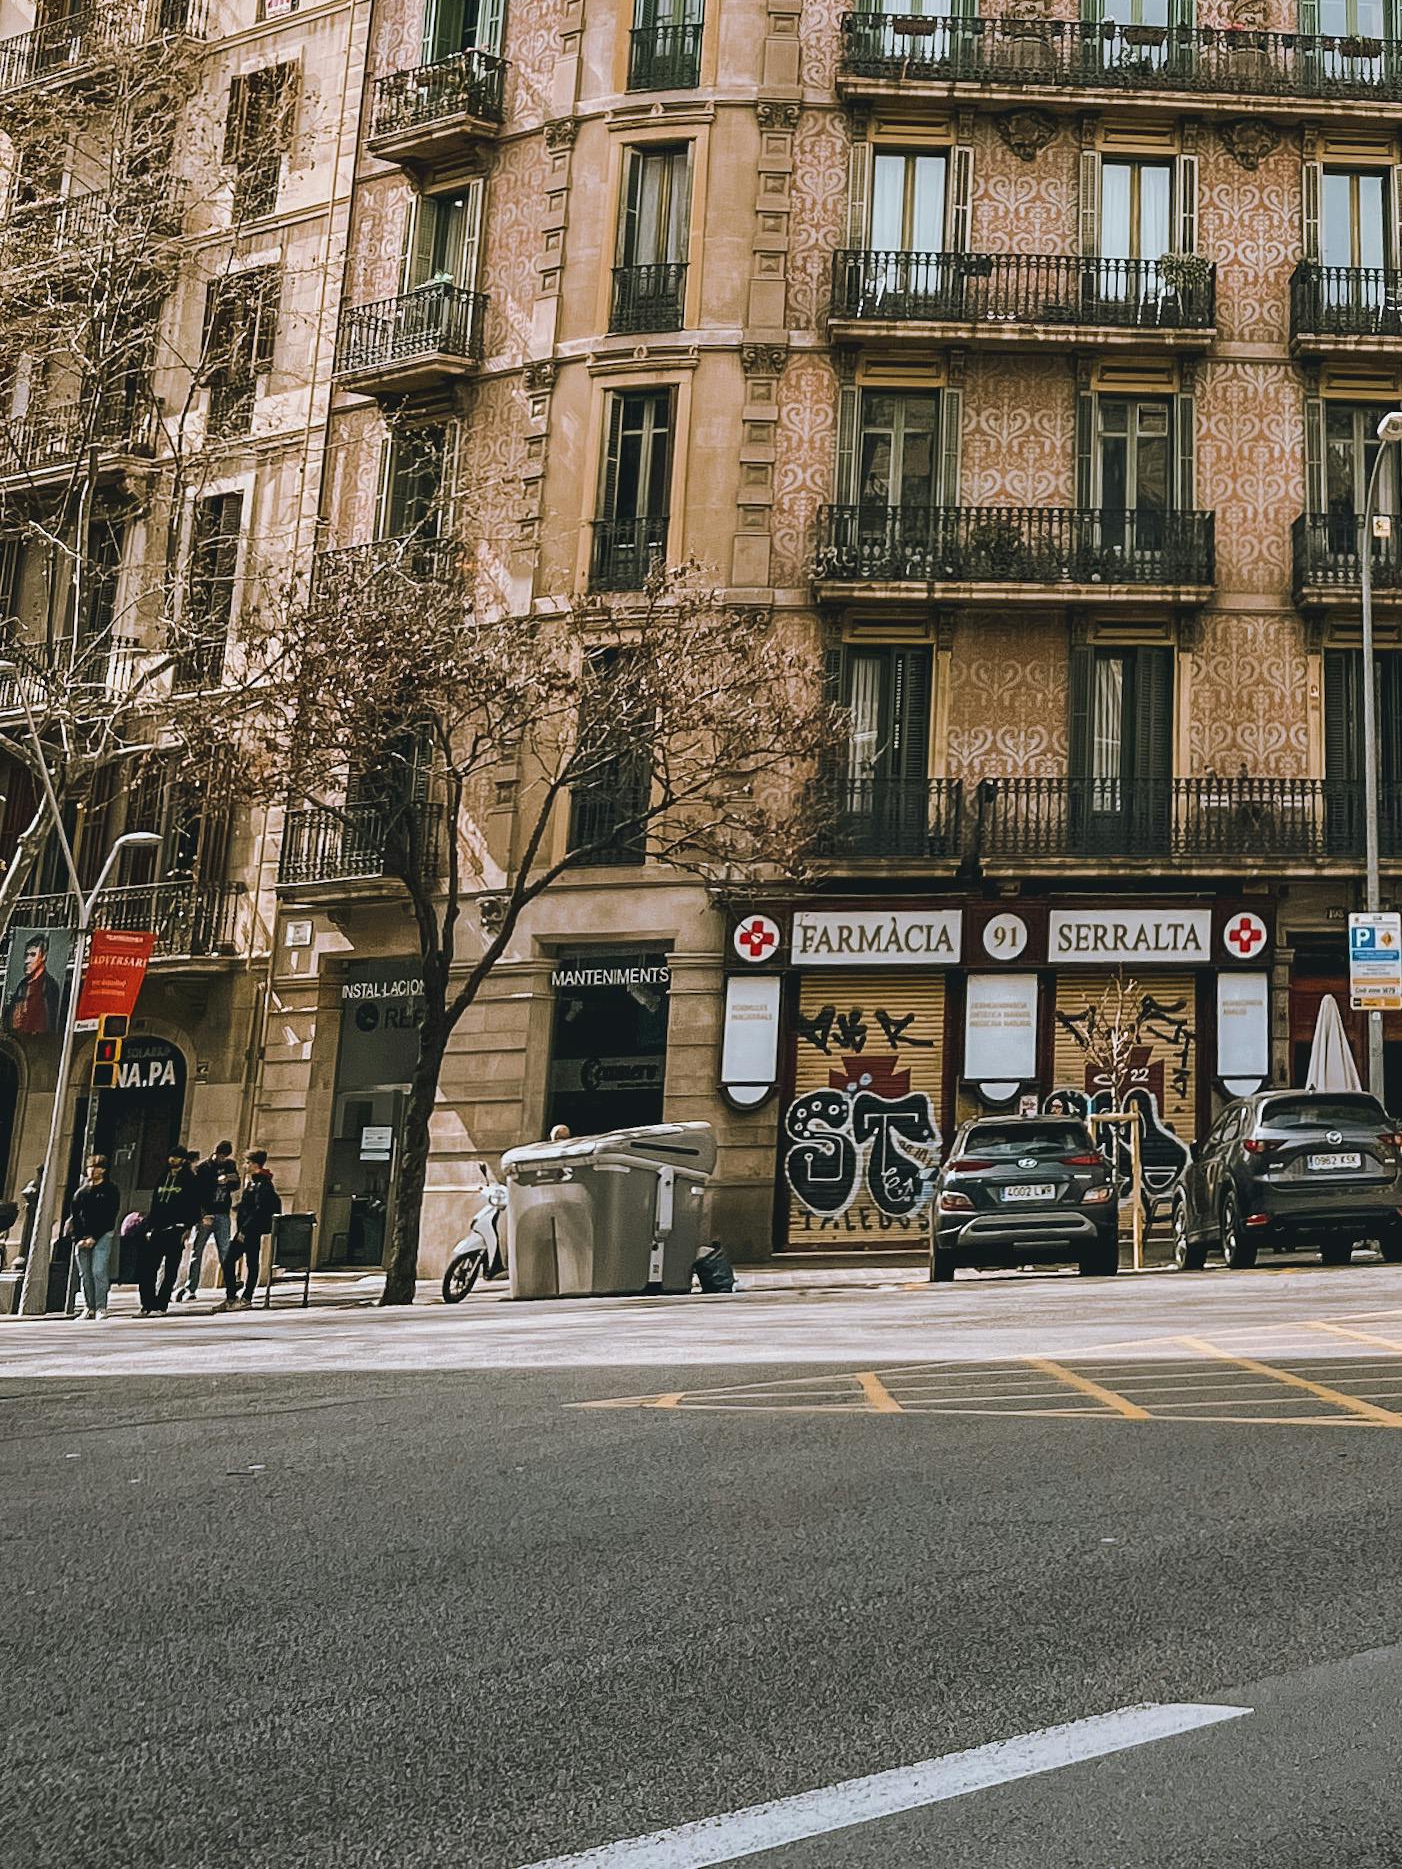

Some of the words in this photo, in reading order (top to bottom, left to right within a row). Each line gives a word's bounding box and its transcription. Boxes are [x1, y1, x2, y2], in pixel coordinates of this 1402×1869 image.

[800, 916, 954, 954] FARMÀCIA
[993, 925, 1018, 948] 91
[1057, 922, 1201, 952] SERRALTA
[551, 966, 669, 986] MANTENIMENTS
